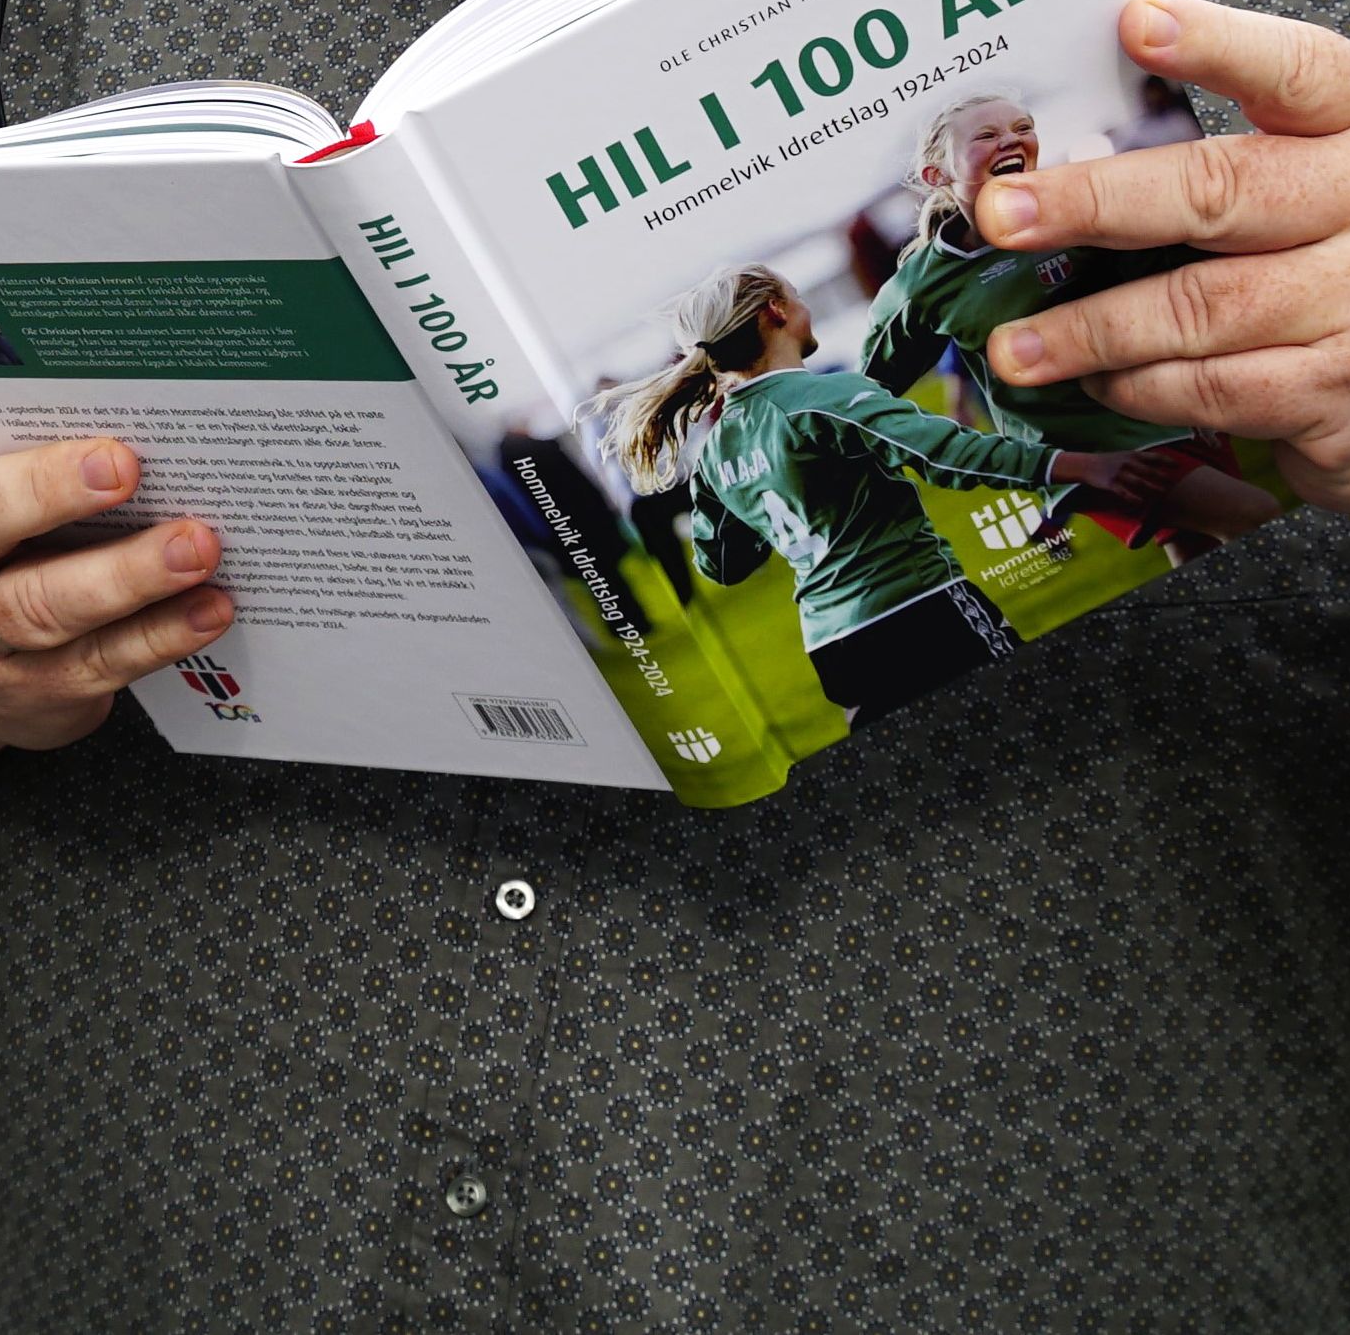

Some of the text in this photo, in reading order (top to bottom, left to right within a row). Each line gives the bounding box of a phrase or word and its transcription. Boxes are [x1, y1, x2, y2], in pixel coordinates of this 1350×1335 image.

[659, 47, 692, 73] OLE
[545, 125, 692, 230] HIL
[699, 91, 742, 150] I
[750, 8, 909, 118] 100
[644, 34, 1010, 231] Hommelvik Idrettslag 1924–2024
[358, 214, 500, 406] HIL I 100 ÅR
[717, 448, 771, 492] MAJA
[970, 491, 1033, 529] HIL
[512, 456, 673, 698] Hommelvik Idrettslag 1924–2024
[980, 528, 1077, 581] Hommelvik
[998, 547, 1073, 589] Idrettslag
[666, 726, 714, 744] HIL
